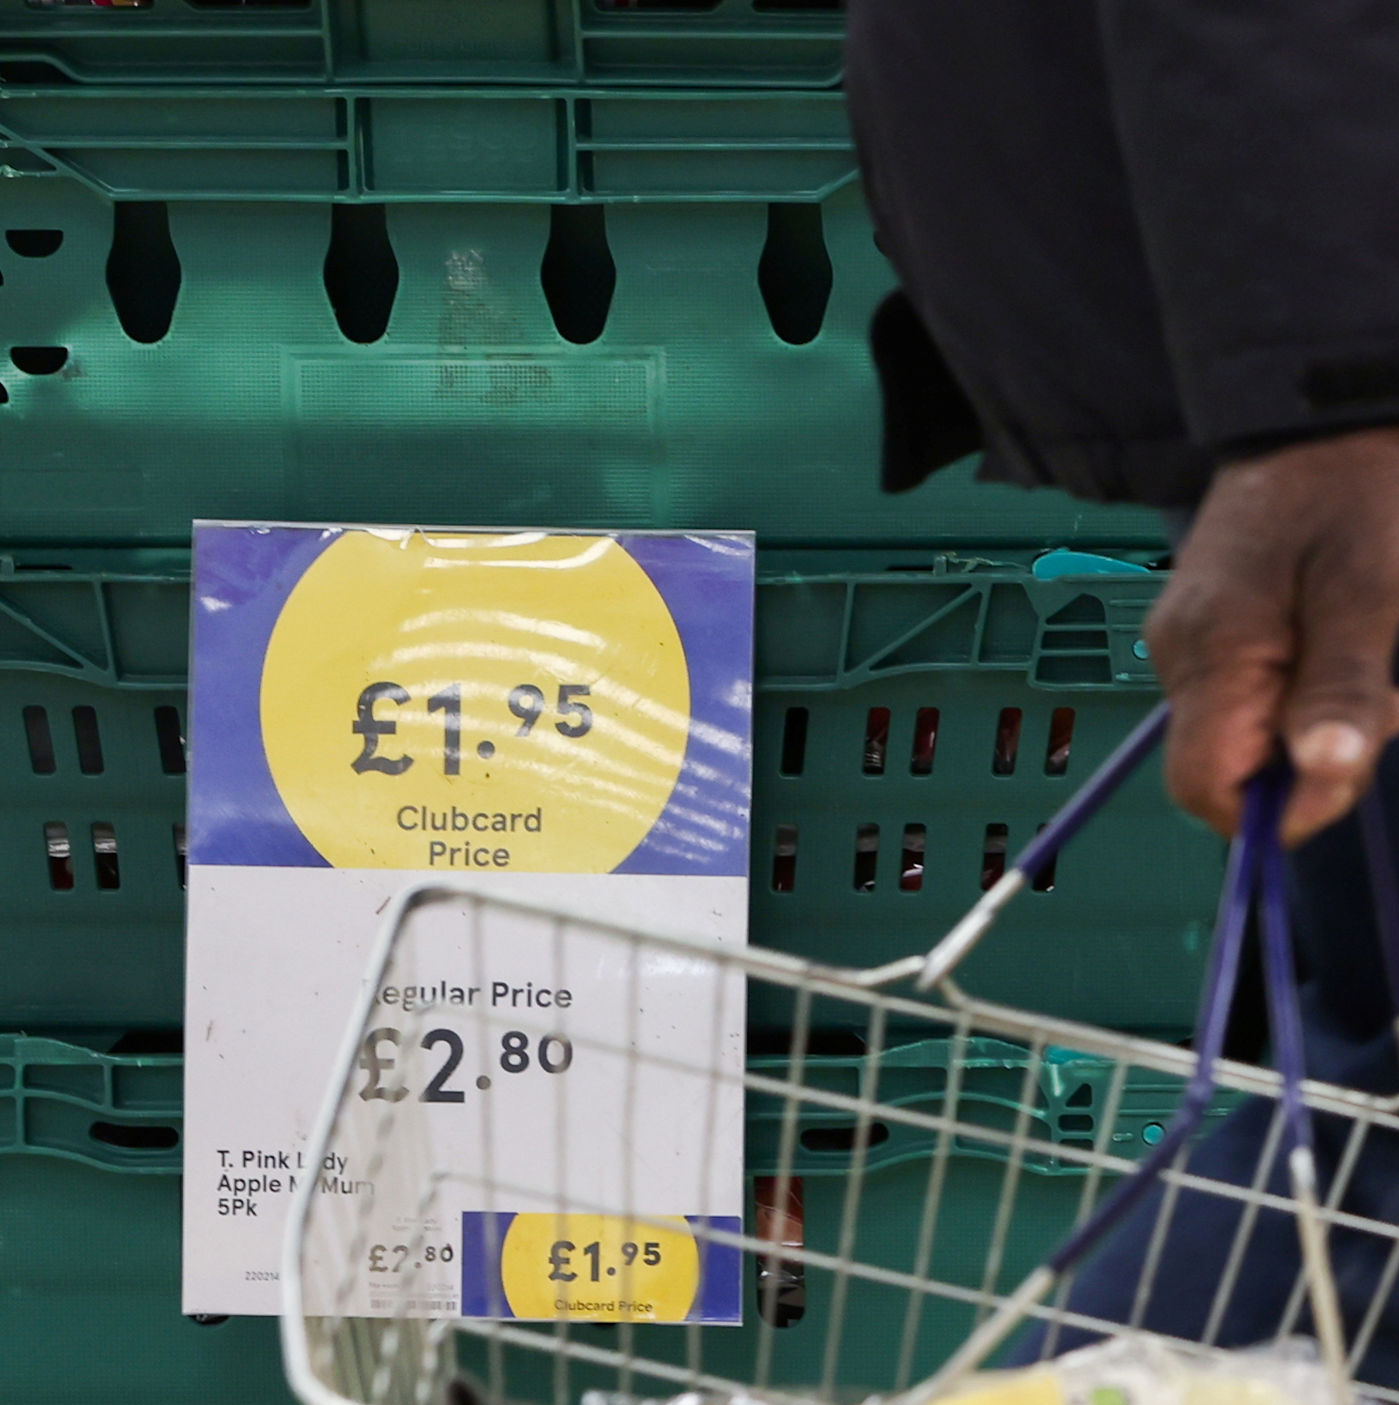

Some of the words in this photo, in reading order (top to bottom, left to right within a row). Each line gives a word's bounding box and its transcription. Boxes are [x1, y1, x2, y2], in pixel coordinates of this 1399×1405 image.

[350, 682, 593, 776] £1.95
[396, 804, 542, 834] Clubcard
[428, 840, 510, 868] Price
[374, 980, 481, 1012] egular
[491, 982, 573, 1008] Price
[359, 1027, 573, 1103] £2.80
[217, 1150, 234, 1169] T.
[242, 1151, 290, 1169] Pink
[298, 1151, 348, 1175] Ldy
[217, 1175, 281, 1195] Apple
[217, 1199, 258, 1217] 5Pk
[368, 1243, 454, 1272] £2.80
[548, 1240, 661, 1282] £1.95
[554, 1299, 614, 1312] Clubcard
[619, 1301, 653, 1312] Price
